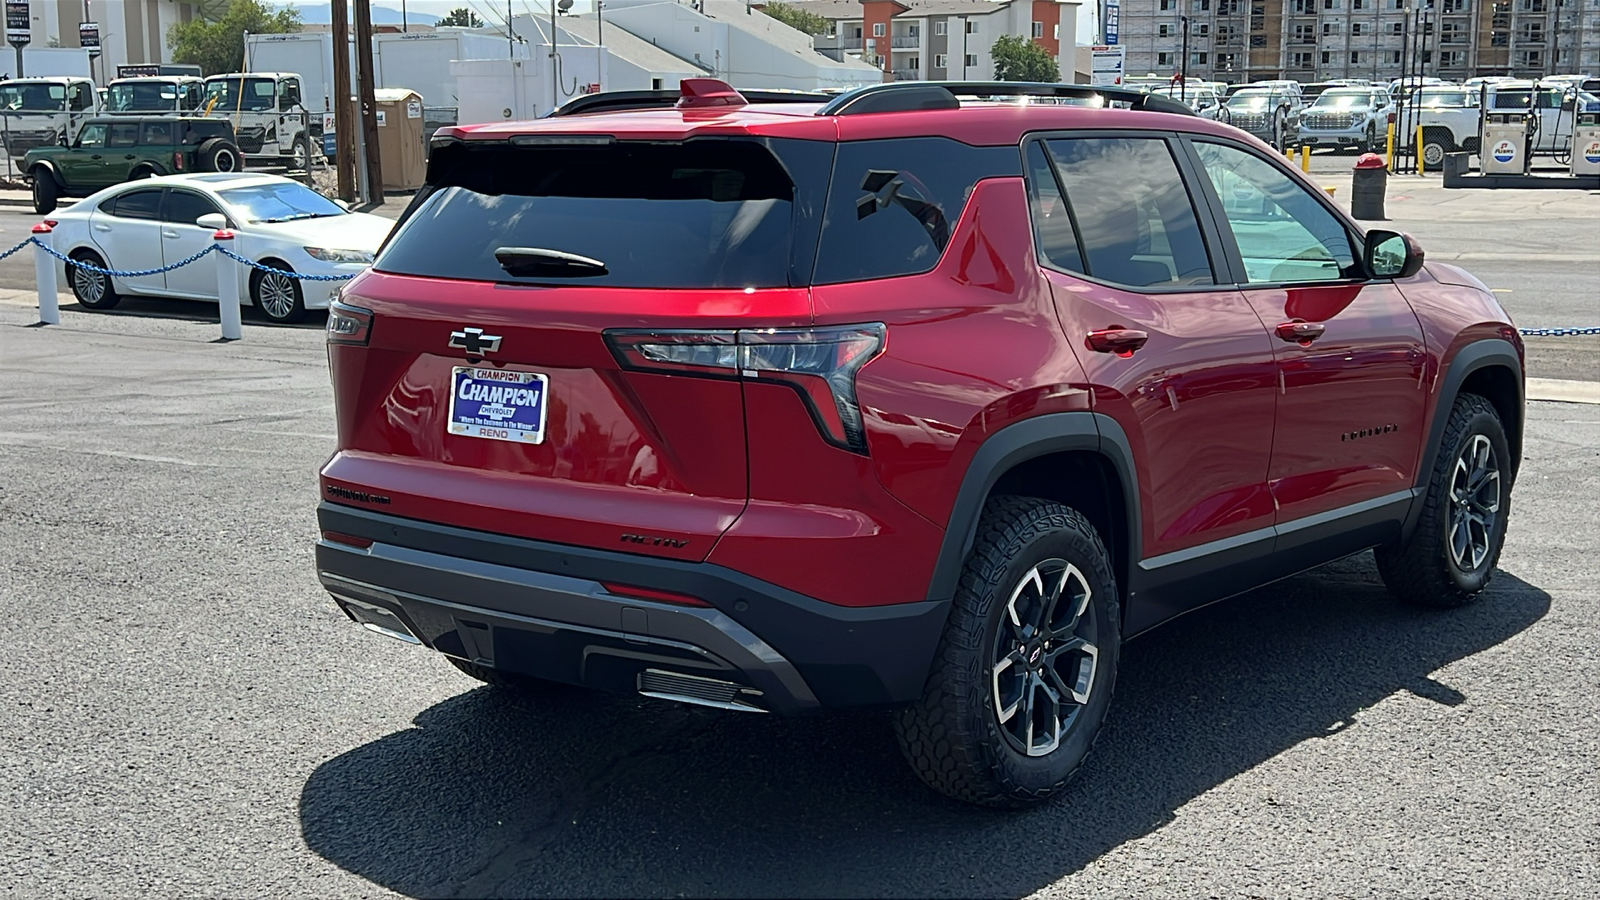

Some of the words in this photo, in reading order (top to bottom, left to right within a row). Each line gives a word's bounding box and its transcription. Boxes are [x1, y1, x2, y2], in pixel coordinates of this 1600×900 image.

[476, 370, 520, 382] CHAMPION
[459, 378, 539, 407] CHAMPION
[481, 406, 513, 416] CHEVROLET
[483, 418, 503, 427] Customer
[479, 428, 508, 439] RENO
[327, 485, 370, 503] EQUINOX
[620, 533, 690, 548] ACTIV
